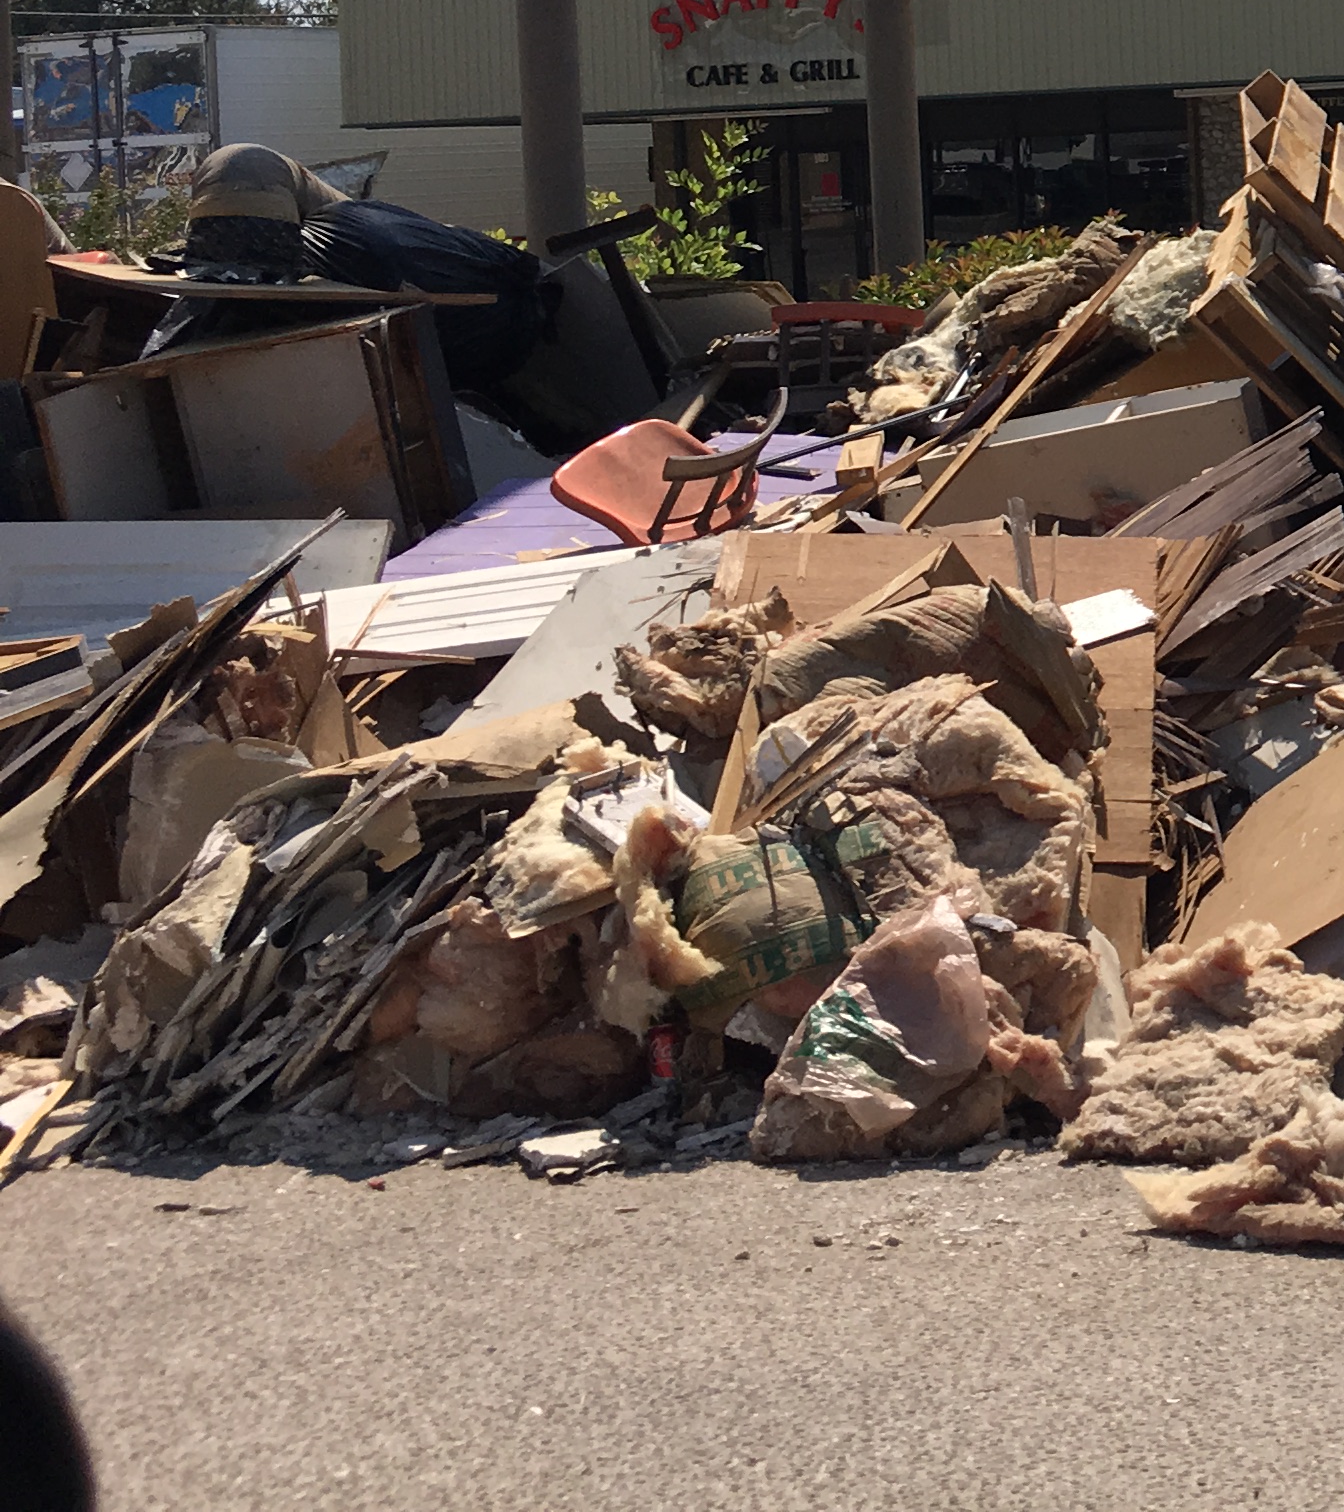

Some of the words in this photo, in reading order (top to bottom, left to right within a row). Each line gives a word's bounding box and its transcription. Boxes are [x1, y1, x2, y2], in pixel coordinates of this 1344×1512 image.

[686, 62, 748, 88] CAFE
[760, 63, 778, 84] &
[790, 58, 860, 83] GRILL
